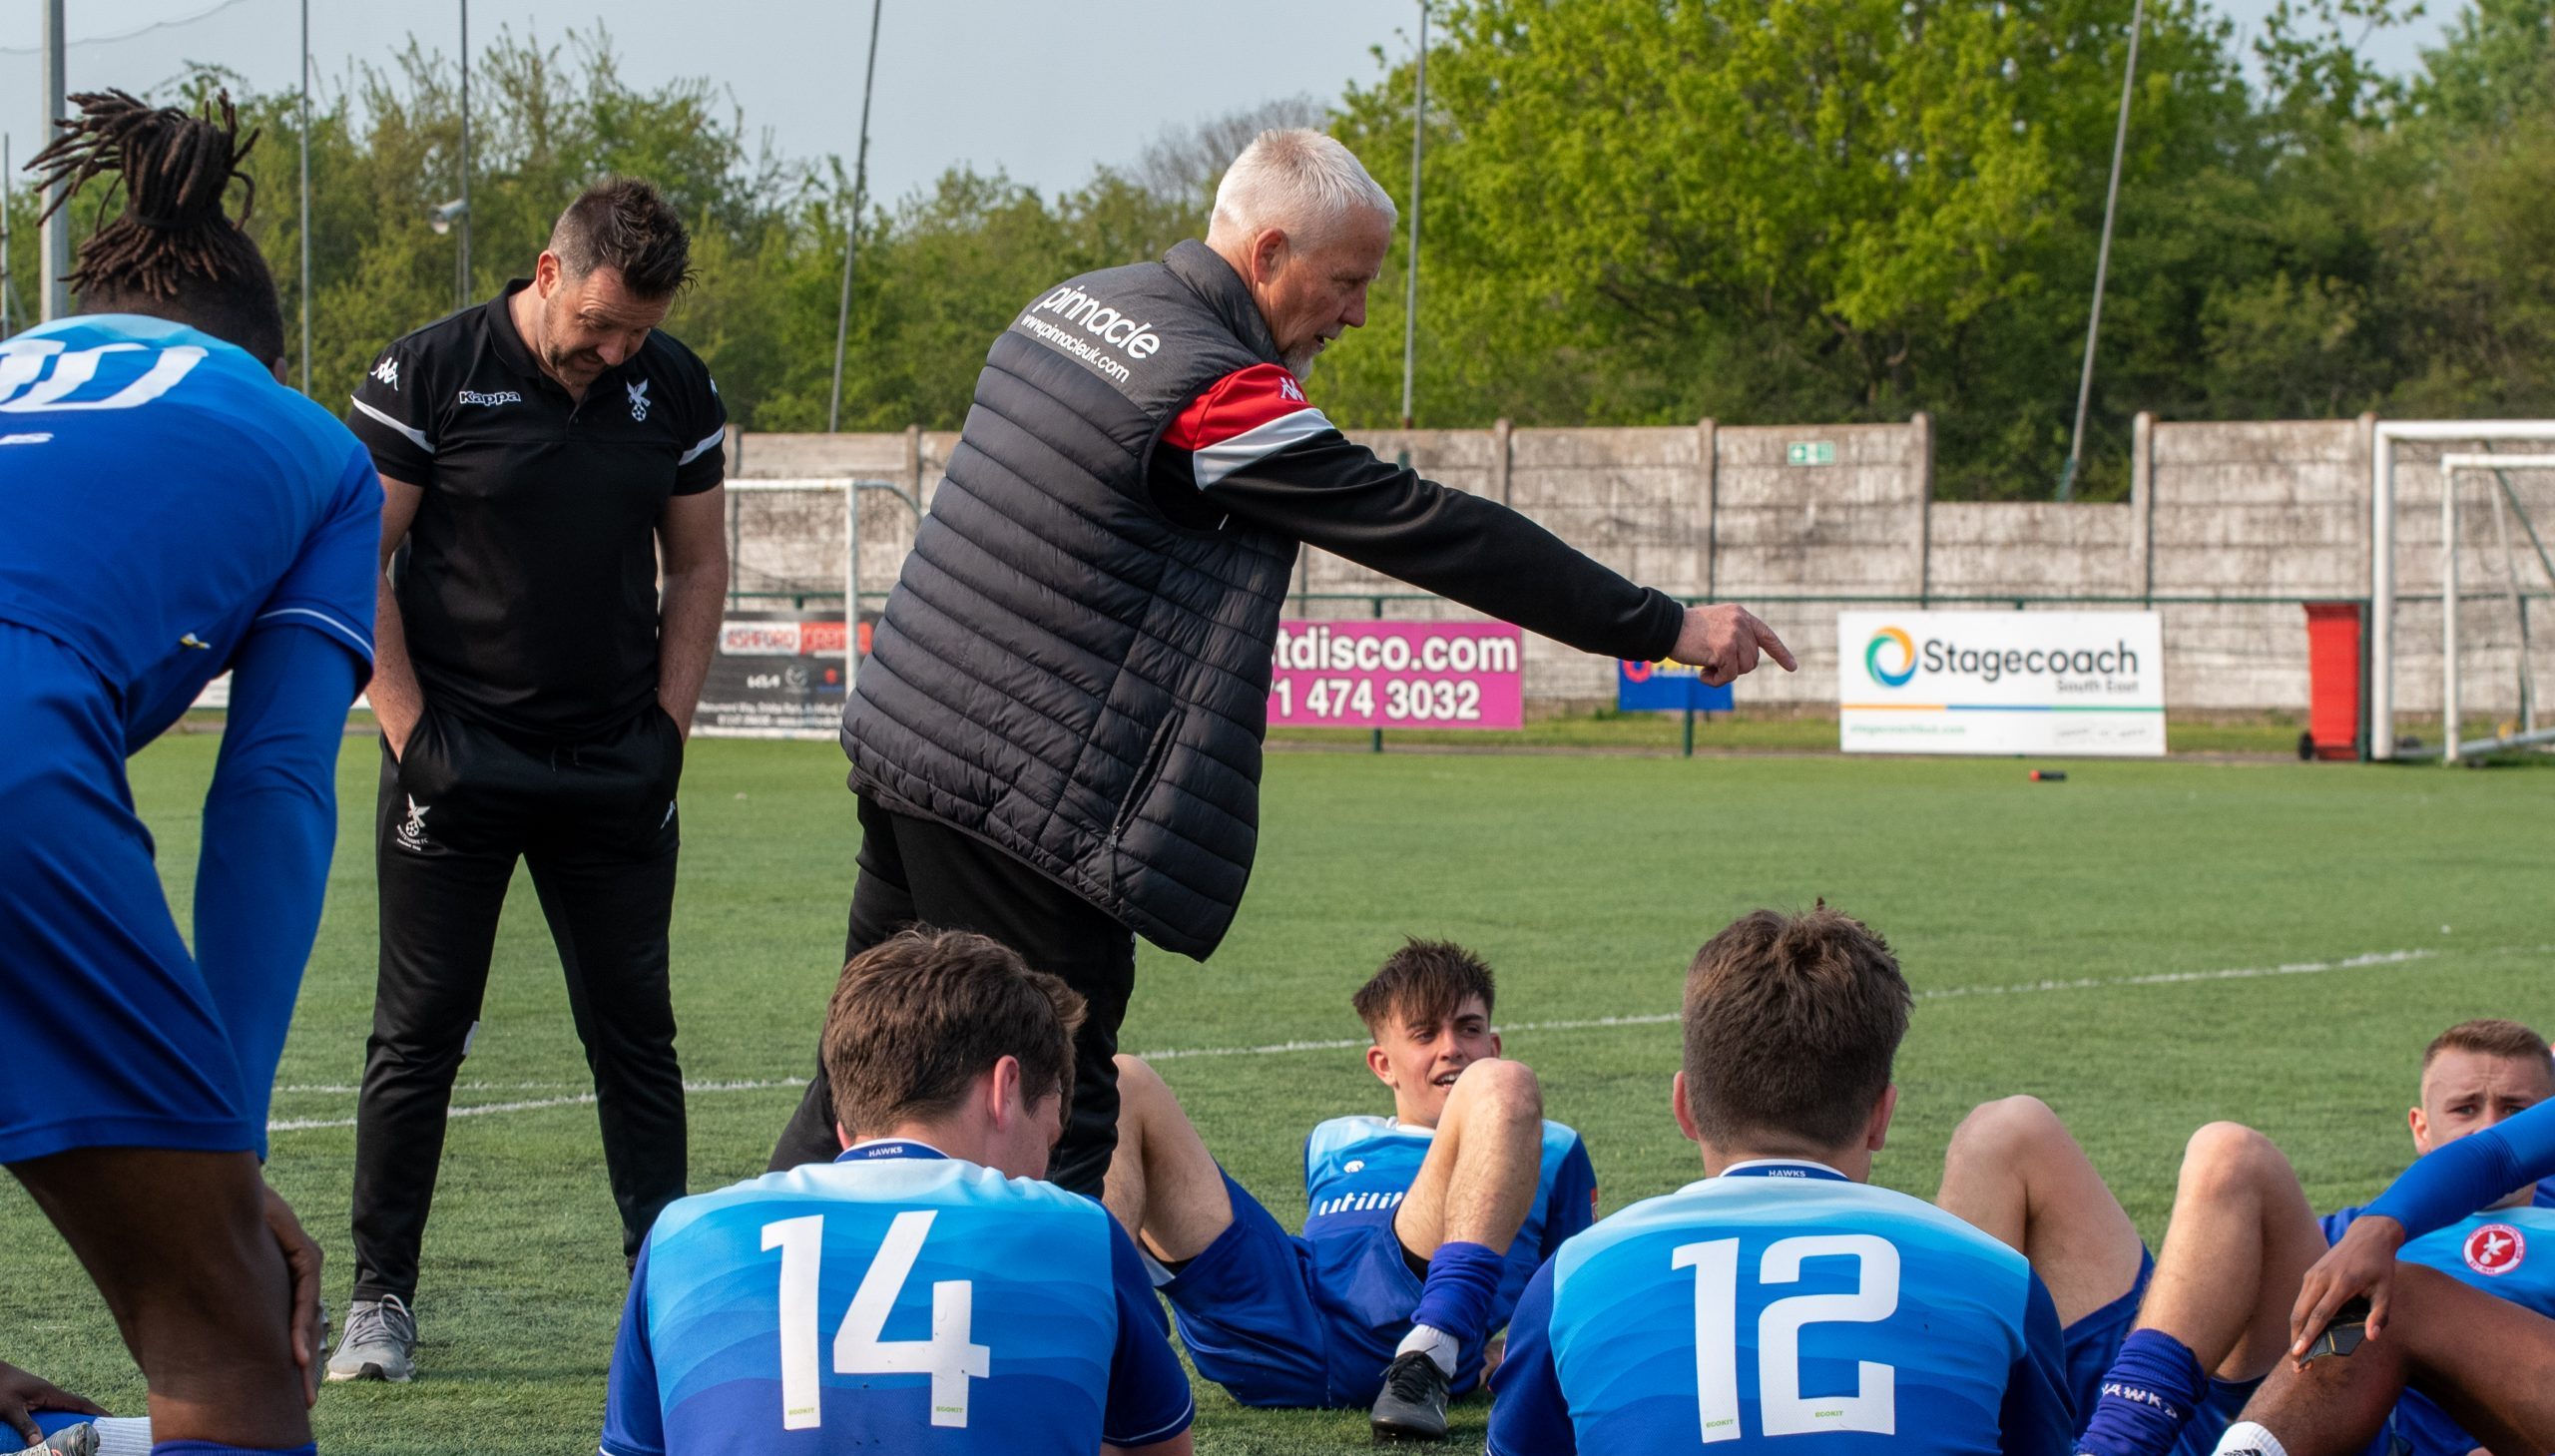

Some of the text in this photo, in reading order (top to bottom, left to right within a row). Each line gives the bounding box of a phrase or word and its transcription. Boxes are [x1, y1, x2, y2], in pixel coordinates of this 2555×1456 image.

[1032, 285, 1160, 359] pinnacle
[1021, 313, 1130, 383] www.pinnacleuk.com
[459, 391, 521, 406] Kappa
[1272, 625, 1518, 673] tdisco.com
[1923, 639, 2139, 683] Stagecoach
[1271, 678, 1481, 721] 1 474 3032
[2056, 680, 2139, 694] South East
[868, 1146, 903, 1158] HAWKS
[761, 1210, 990, 1430] 14
[1671, 1233, 1901, 1444] 12
